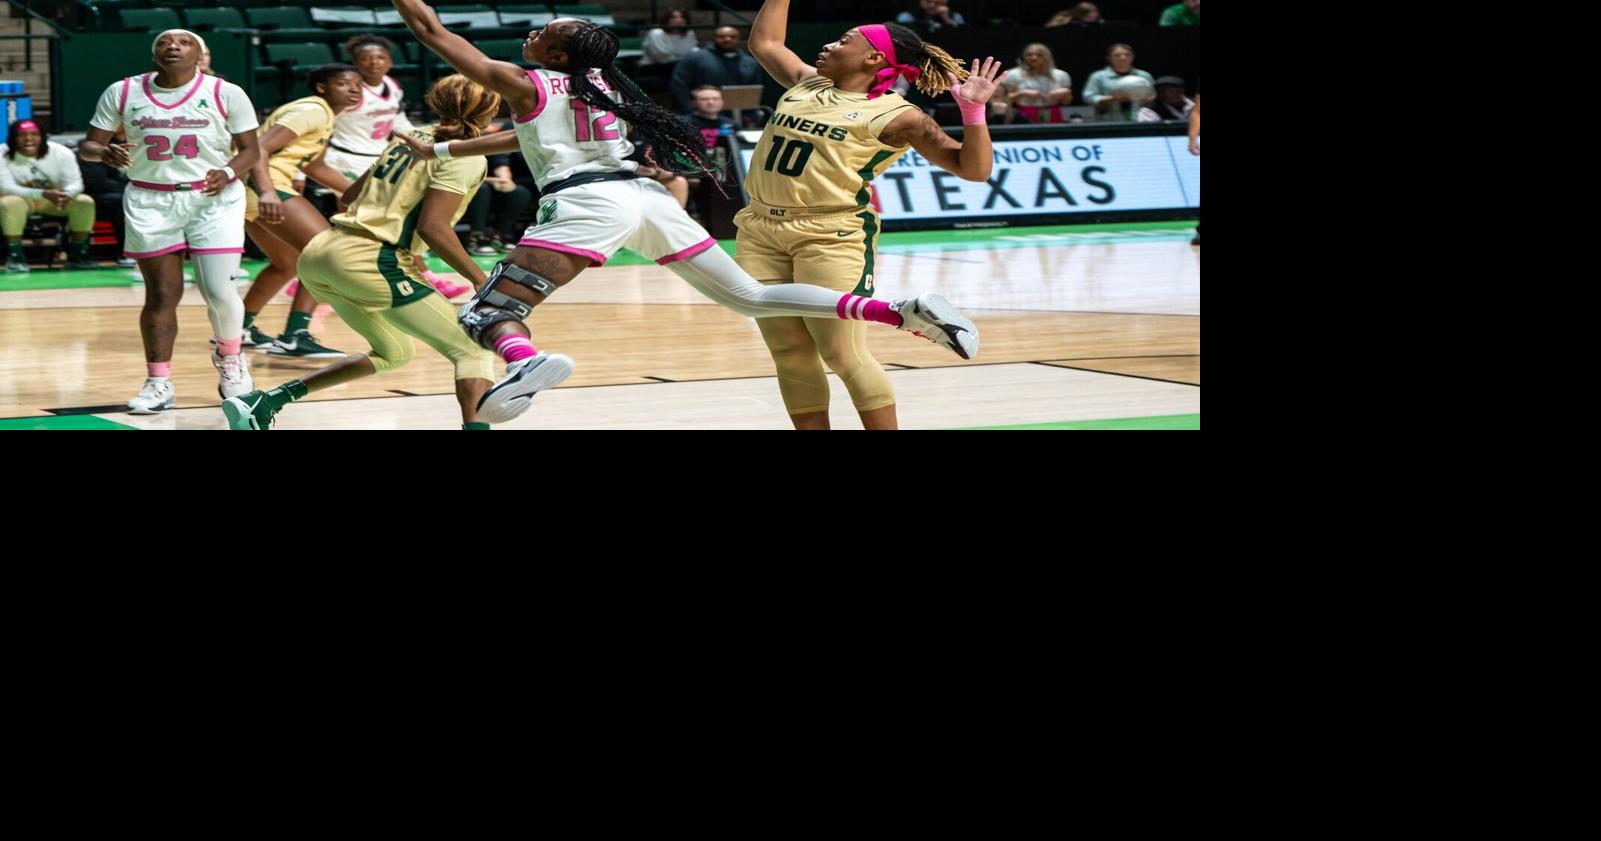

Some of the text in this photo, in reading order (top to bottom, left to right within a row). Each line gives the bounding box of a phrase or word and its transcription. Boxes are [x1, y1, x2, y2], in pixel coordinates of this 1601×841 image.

[569, 98, 619, 142] 12
[143, 134, 200, 161] 24
[373, 143, 413, 185] 31
[763, 135, 815, 178] 10
[993, 146, 1063, 164] NION
[1072, 145, 1104, 161] OF
[883, 165, 1117, 213] TEXAS
